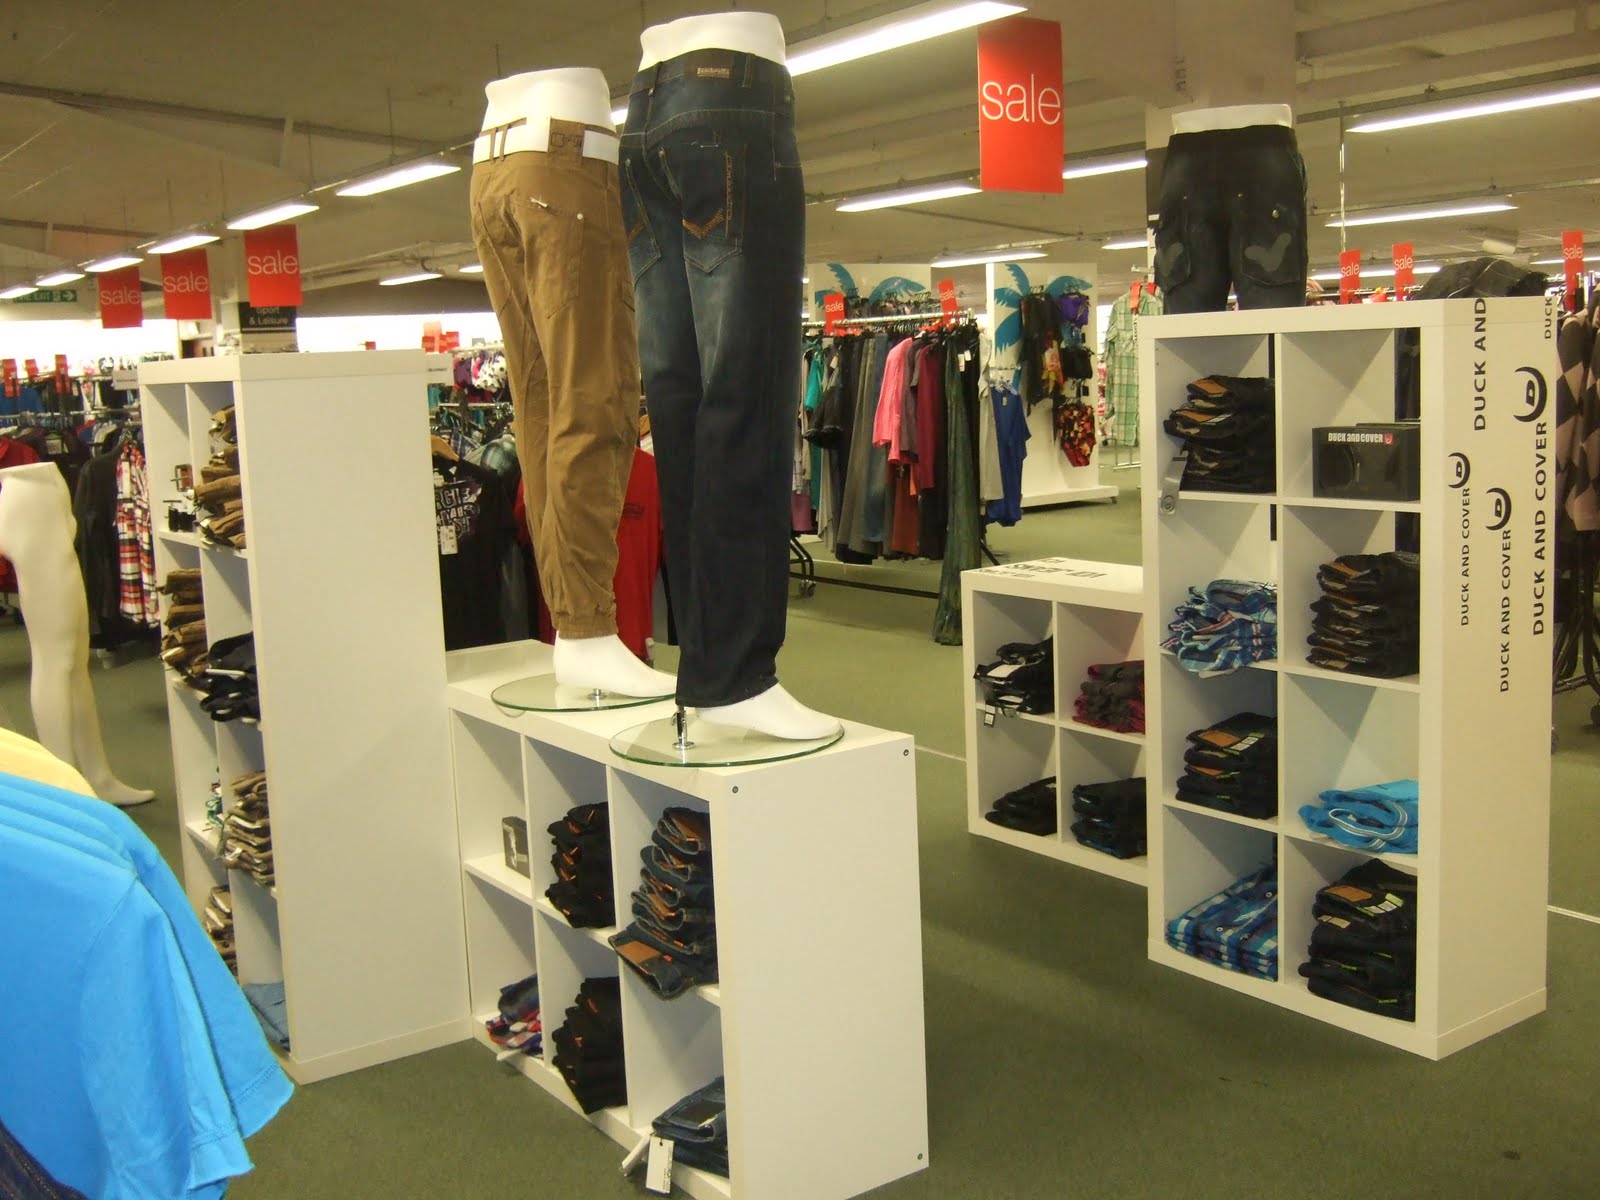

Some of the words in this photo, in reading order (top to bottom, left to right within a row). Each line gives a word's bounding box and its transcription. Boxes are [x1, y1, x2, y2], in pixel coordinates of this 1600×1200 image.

[981, 73, 1061, 125] sale
[247, 249, 298, 275] sale
[1341, 262, 1360, 277] sale
[1394, 255, 1413, 271] sale
[1564, 244, 1583, 259] sale
[100, 286, 140, 305] sale
[163, 271, 209, 293] sale
[940, 289, 955, 301] sale
[825, 301, 844, 313] sale
[1474, 298, 1487, 351] AND
[1474, 360, 1487, 430] DUCK
[1535, 422, 1547, 501] COVER
[1462, 488, 1470, 539] COVER
[1534, 510, 1545, 560] AND
[1461, 545, 1469, 577] AND
[1502, 529, 1511, 590] COVER
[1461, 583, 1469, 626] DUCK
[1501, 596, 1510, 635] AND
[1533, 569, 1545, 635] DUCK
[1500, 641, 1509, 692] DUCK
